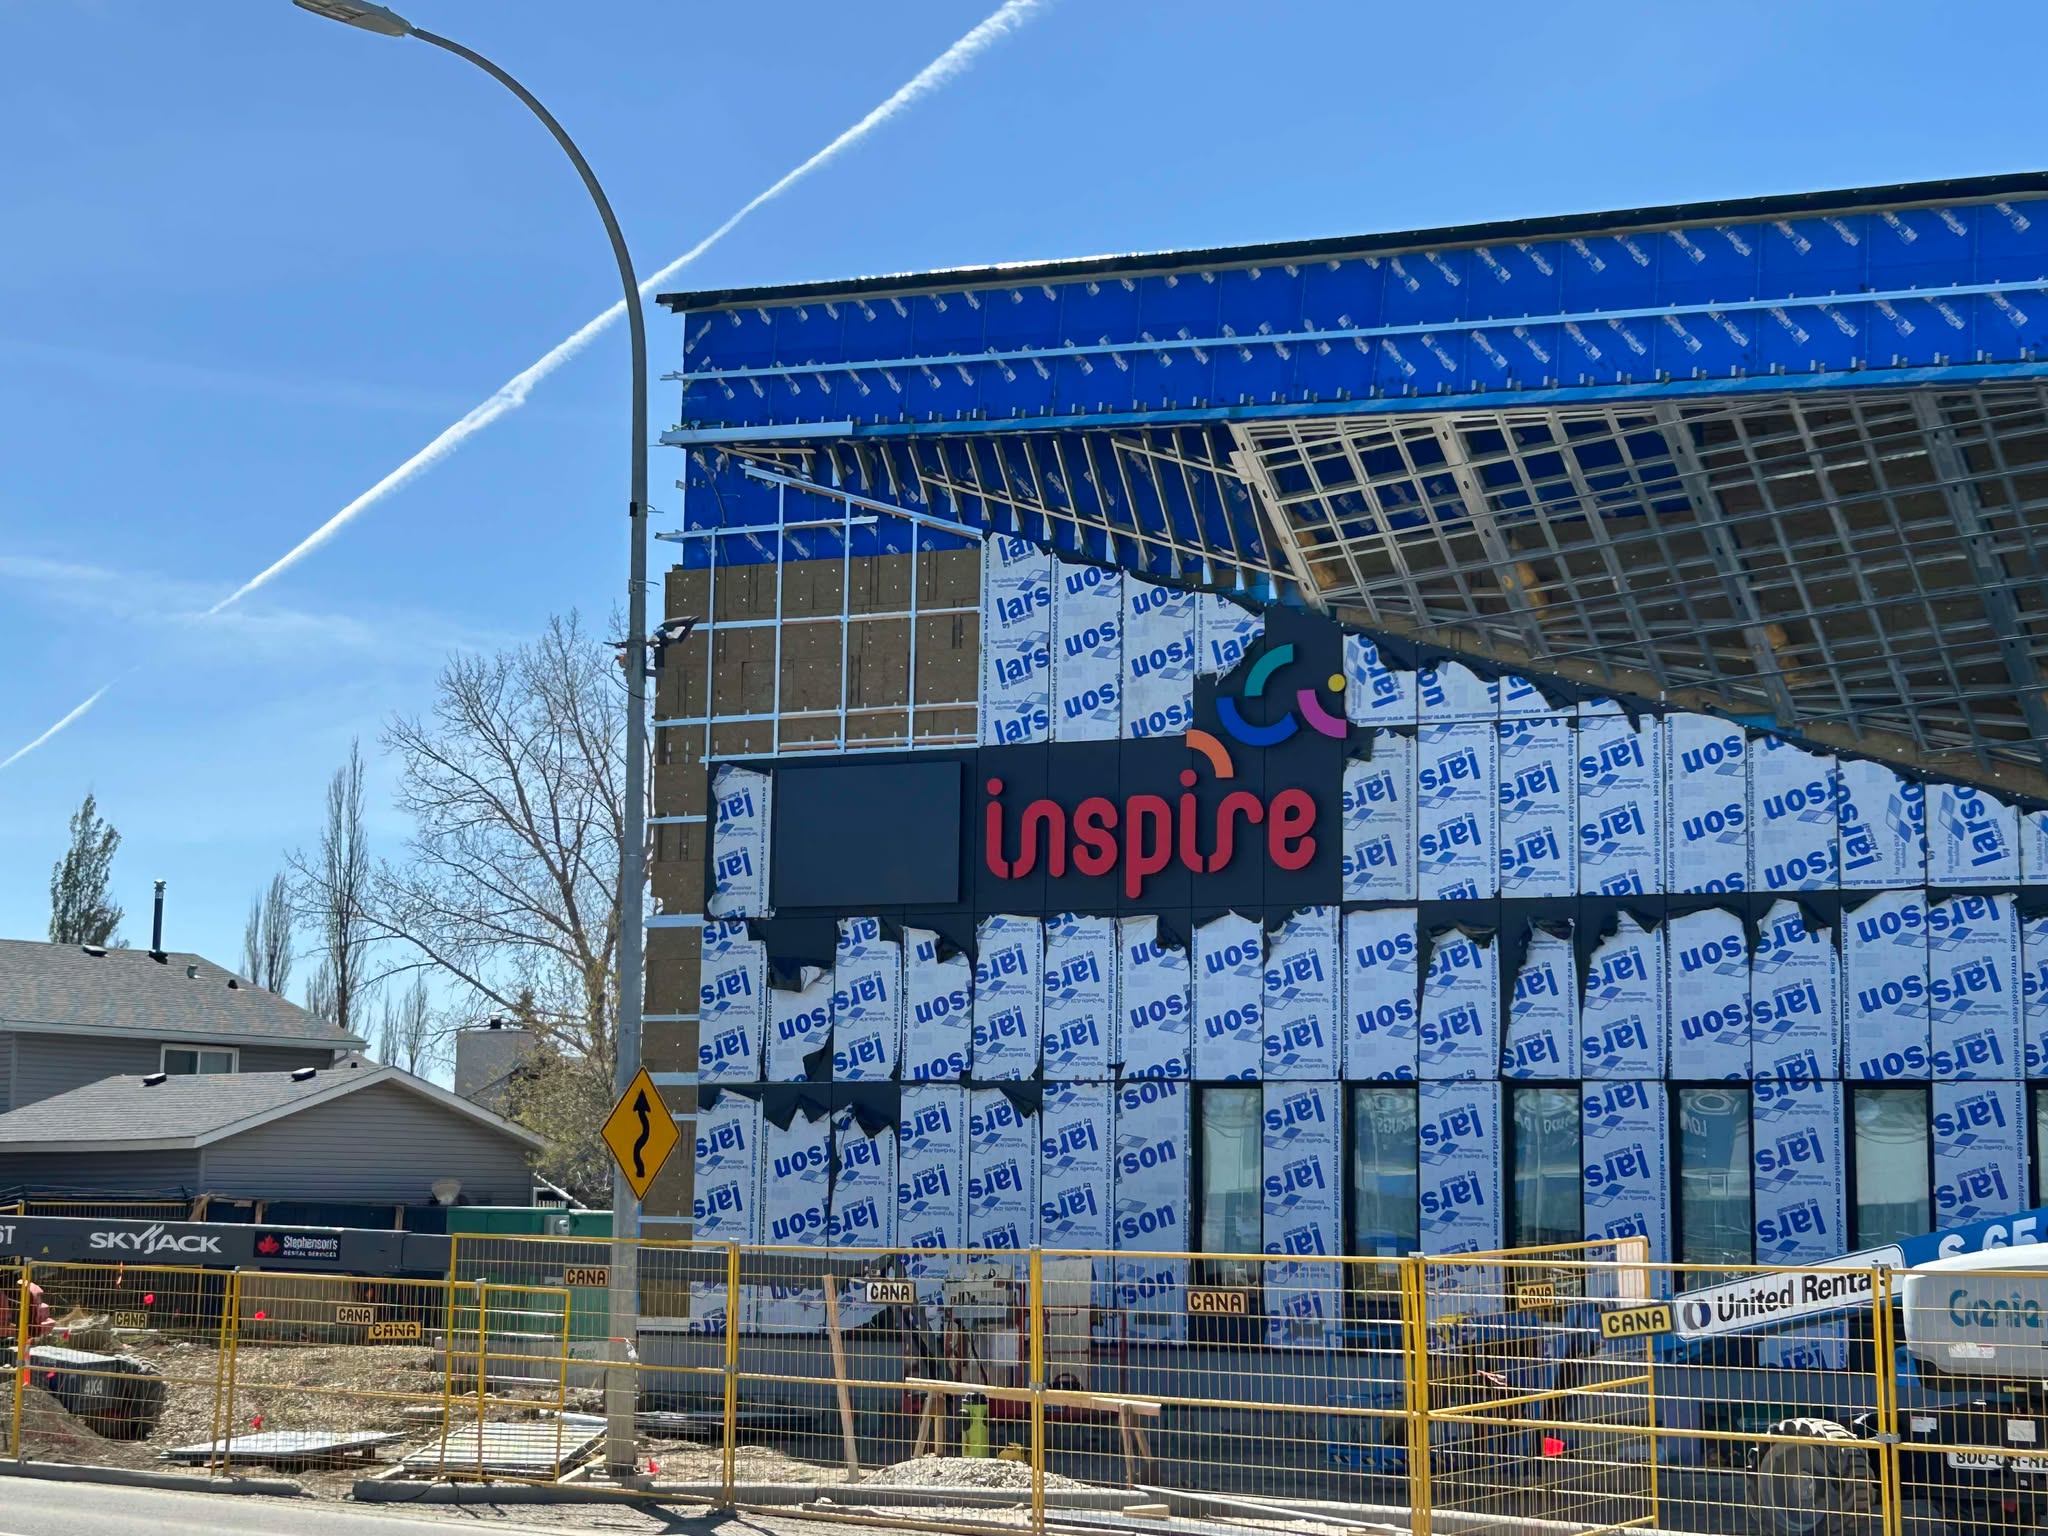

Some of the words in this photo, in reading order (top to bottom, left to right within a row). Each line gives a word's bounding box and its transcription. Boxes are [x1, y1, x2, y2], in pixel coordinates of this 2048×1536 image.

[996, 586, 1051, 623] lars
[995, 649, 1050, 685] lars
[994, 709, 1049, 744] lars
[1419, 752, 1480, 790] lars
[1579, 740, 1644, 778] lars
[1681, 735, 1743, 773] son
[1500, 766, 1560, 803] lars
[986, 769, 1316, 899] inspire
[1419, 818, 1481, 855] lars
[1580, 807, 1645, 845] lars
[1683, 804, 1744, 841] son
[1500, 832, 1560, 869] lars
[976, 949, 1028, 984] lars
[1045, 957, 1100, 991] lars
[1265, 957, 1324, 991] lars
[1930, 964, 2002, 1003] lars
[701, 971, 751, 1004] lars
[833, 976, 887, 1010] lars
[1753, 984, 1821, 1024] lars
[974, 1011, 1027, 1046] lars
[1044, 1020, 1099, 1054] lars
[1264, 1021, 1324, 1056] lars
[1420, 1008, 1482, 1045] lars
[1583, 1020, 1648, 1059] lars
[699, 1031, 749, 1065] lars
[833, 1038, 885, 1072] lars
[1932, 1036, 2004, 1075] lars
[1265, 1094, 1325, 1131] lars
[1583, 1081, 1649, 1118] lars
[1935, 1098, 2006, 1136] lars
[696, 1125, 745, 1157] lars
[900, 1108, 952, 1141] lars
[1043, 1124, 1098, 1158] lars
[1421, 1109, 1483, 1146] lars
[1584, 1148, 1650, 1187] lars
[1756, 1135, 1825, 1172] lars
[898, 1169, 950, 1203] lars
[970, 1165, 1022, 1198] lars
[1265, 1161, 1325, 1198] lars
[1421, 1177, 1484, 1213] lars
[1936, 1170, 2008, 1209] lars
[694, 1186, 742, 1219] lars
[829, 1201, 879, 1235] lars
[1042, 1188, 1097, 1223] lars
[90, 1224, 222, 1255] SKYJACK
[1757, 1206, 1826, 1243] lars
[568, 1270, 606, 1285] CANA
[870, 1284, 910, 1301] CANA
[339, 1308, 371, 1322] CANA
[1190, 1292, 1242, 1312] CANA
[1717, 1279, 1793, 1321] United
[116, 1313, 146, 1327] CANA
[373, 1323, 416, 1337] CANA
[1607, 1310, 1665, 1333] CANA
